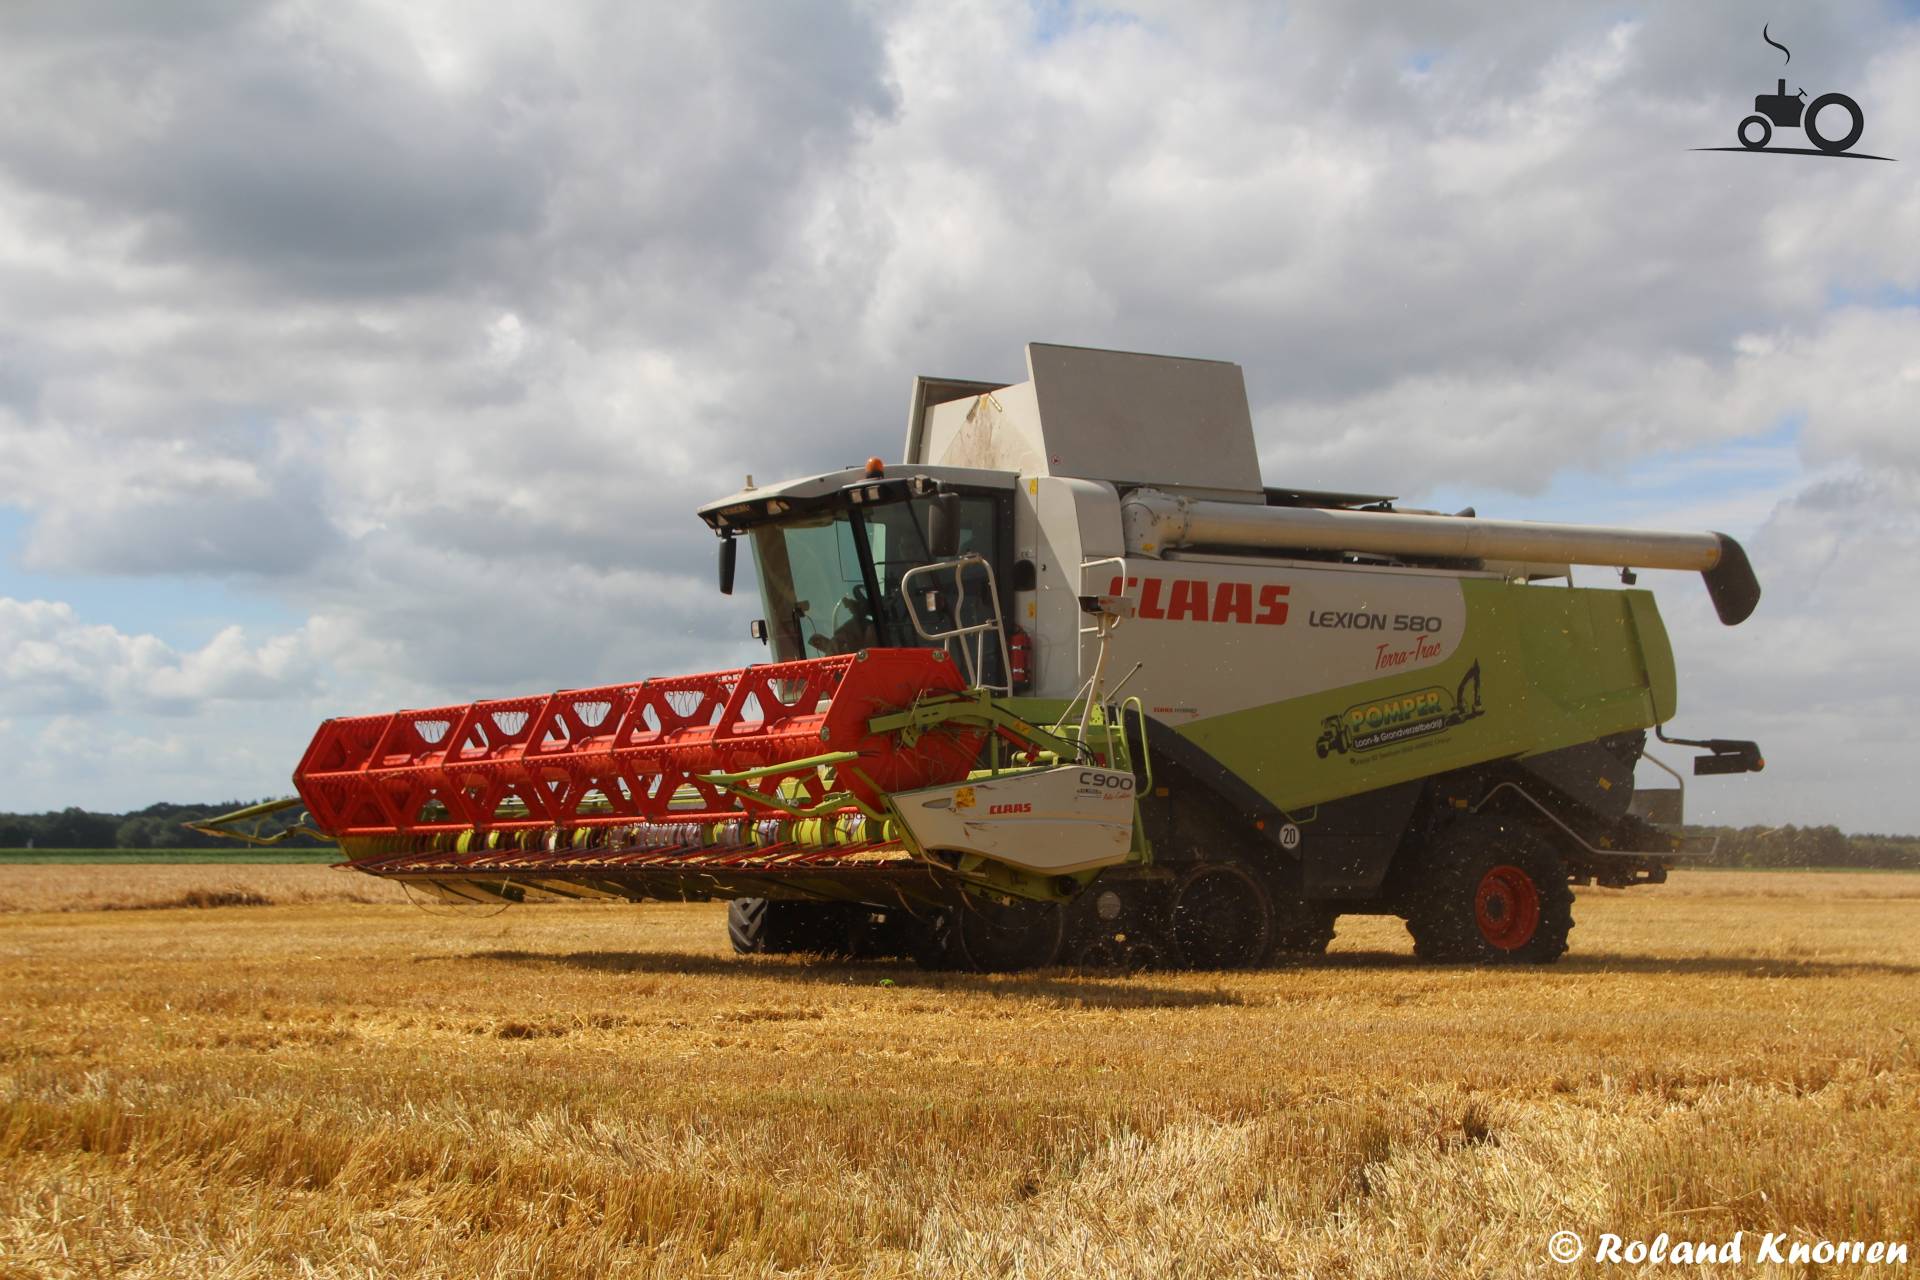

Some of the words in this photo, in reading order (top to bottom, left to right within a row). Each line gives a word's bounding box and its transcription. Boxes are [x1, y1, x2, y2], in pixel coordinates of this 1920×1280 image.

[1308, 610, 1388, 631] LEXION
[1392, 614, 1443, 634] 580
[1375, 634, 1442, 671] Terra-Trac
[1351, 691, 1443, 733] POMPER
[1079, 771, 1134, 791] C900
[989, 802, 1032, 815] CLAAS
[1283, 827, 1296, 845] 20
